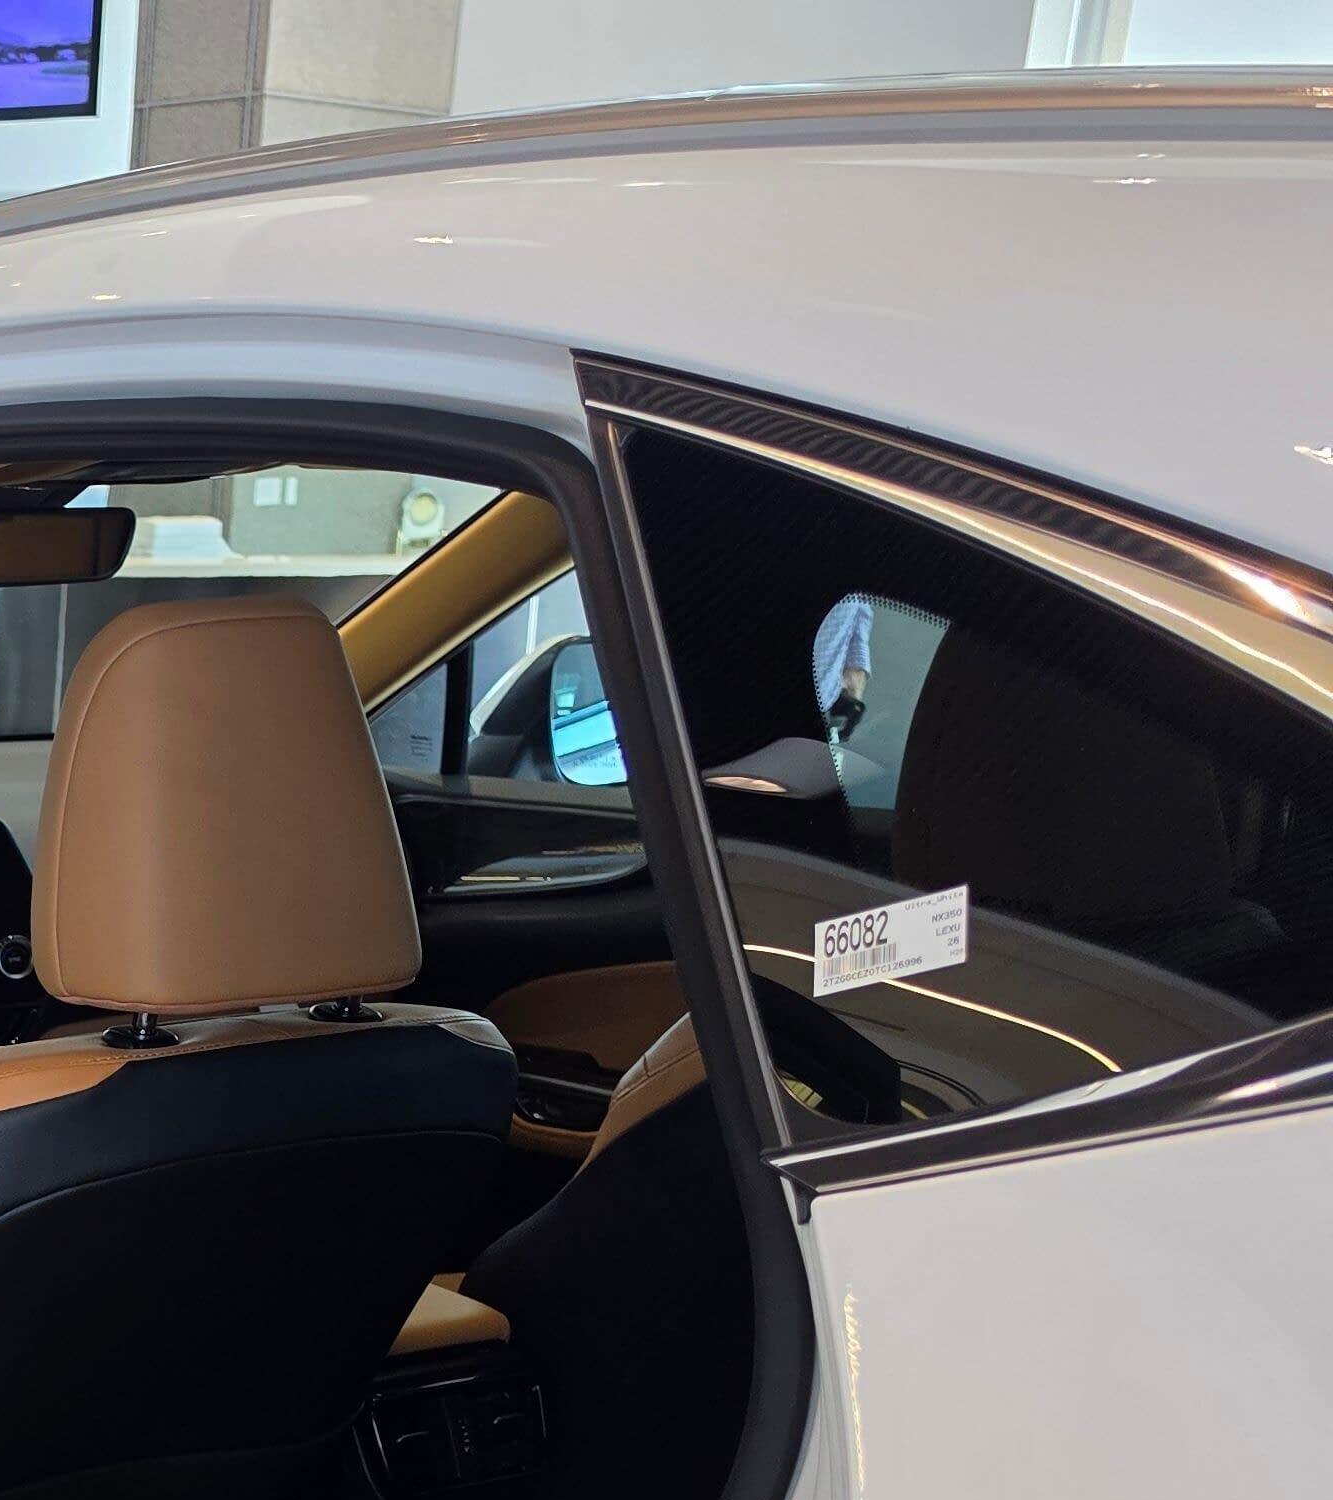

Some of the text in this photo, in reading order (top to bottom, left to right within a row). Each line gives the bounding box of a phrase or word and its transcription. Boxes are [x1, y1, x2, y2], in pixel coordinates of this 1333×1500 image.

[932, 908, 963, 923] NX350
[824, 910, 888, 957] 66082
[936, 923, 961, 936] LEXU
